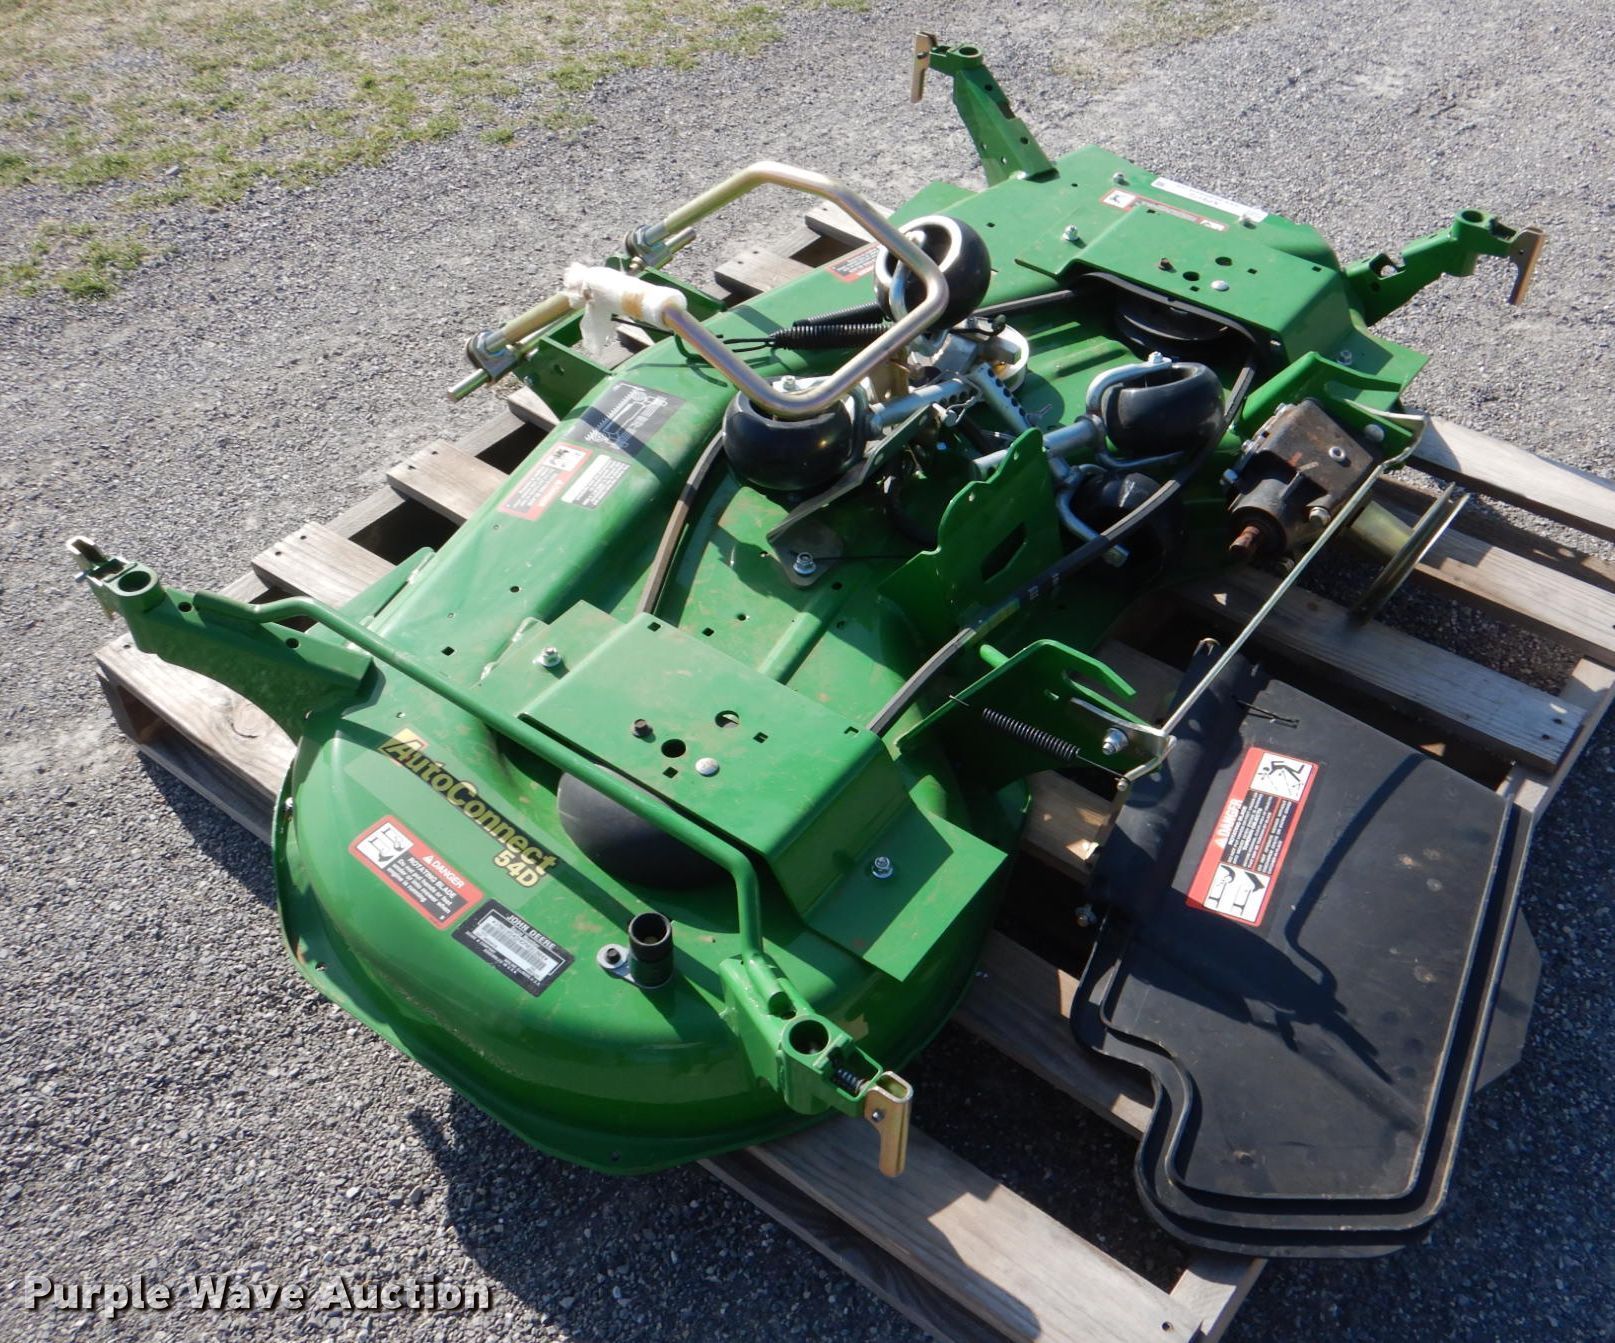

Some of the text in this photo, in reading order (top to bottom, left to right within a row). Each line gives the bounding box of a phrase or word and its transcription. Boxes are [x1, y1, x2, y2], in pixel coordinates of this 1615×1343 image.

[380, 732, 557, 876] AutoConnect
[1216, 797, 1243, 837] DANGER
[407, 856, 456, 898] ROTATING BLADE
[430, 859, 465, 889] DANGER
[494, 849, 542, 889] 54D
[506, 913, 530, 931] JOHN
[528, 928, 556, 950] DEERE
